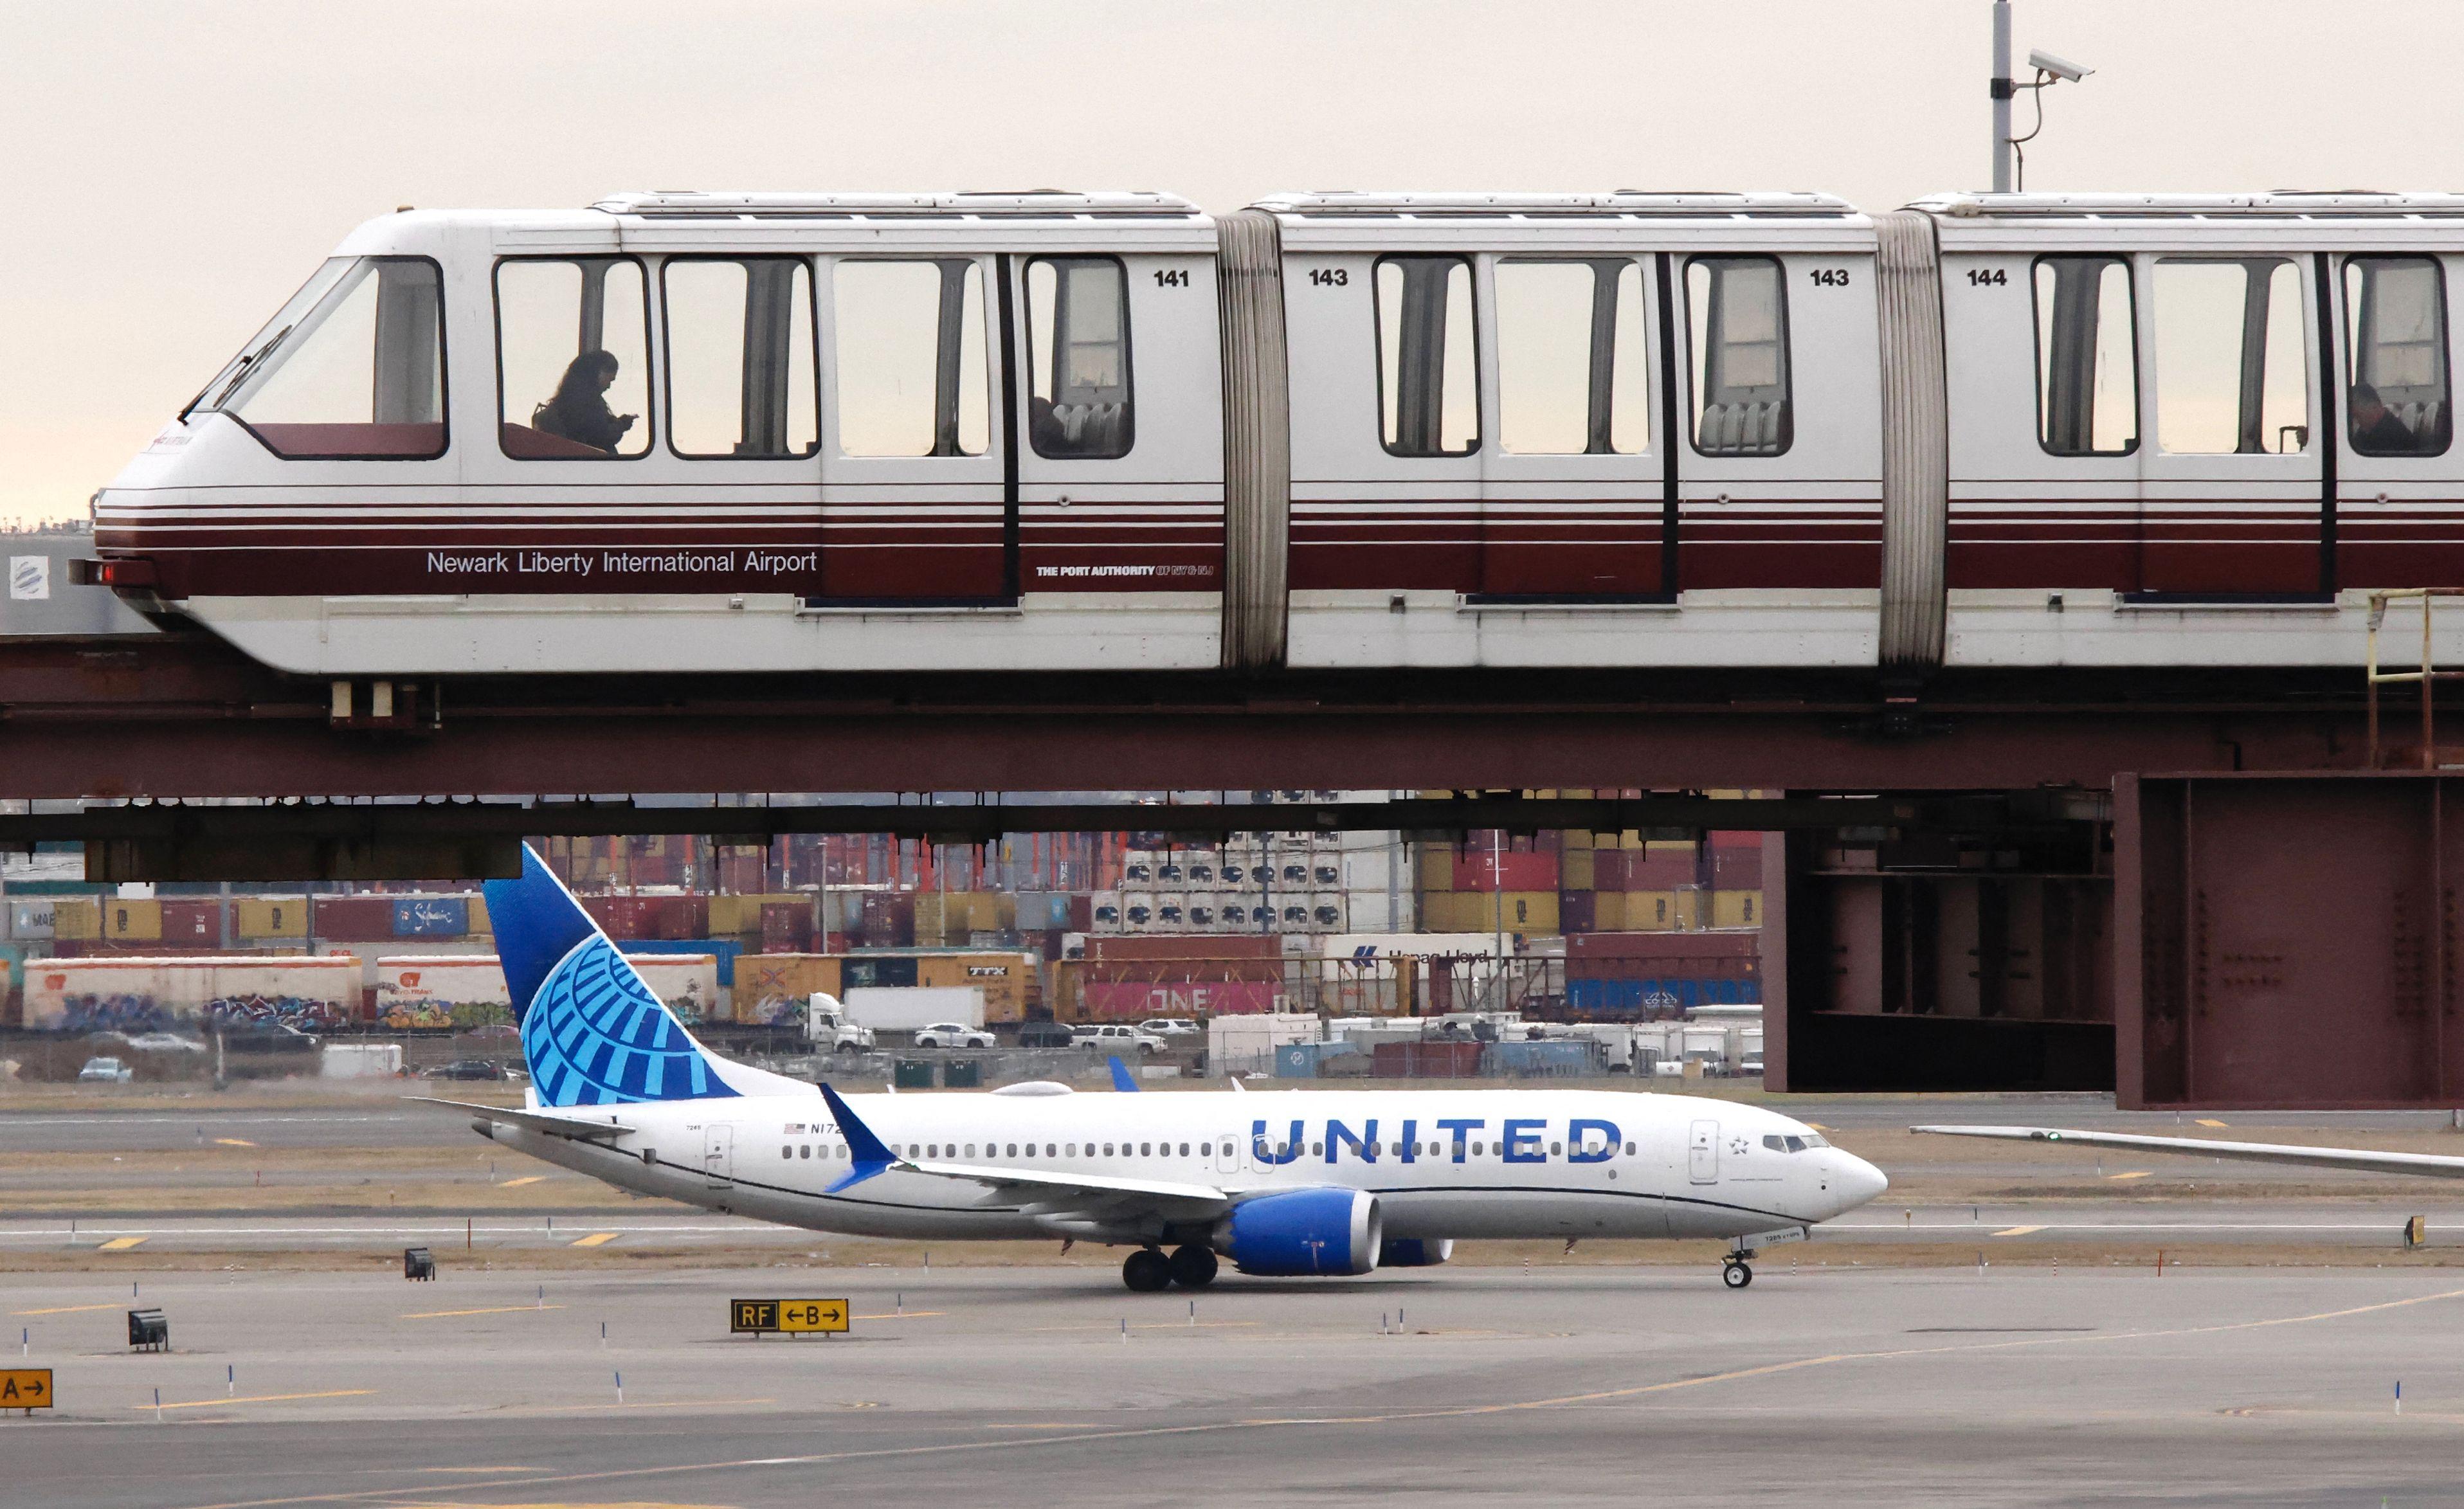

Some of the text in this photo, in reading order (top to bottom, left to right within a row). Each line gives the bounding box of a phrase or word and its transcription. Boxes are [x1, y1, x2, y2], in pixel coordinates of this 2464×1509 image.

[1154, 270, 1189, 287] 141
[1309, 269, 1348, 286] 143
[1810, 269, 1849, 286] 143
[1967, 269, 2007, 286] 144
[428, 551, 817, 577] Newark Liberty International Airport
[1036, 566, 1058, 577] THE
[1060, 566, 1091, 577] PORT
[1091, 565, 1155, 576] AUTHORITY
[1155, 566, 1170, 575] OF
[1171, 566, 1188, 575] NY
[1197, 566, 1214, 575] NJ
[969, 966, 1006, 976] TTX
[1147, 989, 1208, 1011] ONE
[1252, 1119, 1622, 1165] UNITED
[742, 1305, 819, 1326] RF B
[3, 1378, 20, 1400] A
